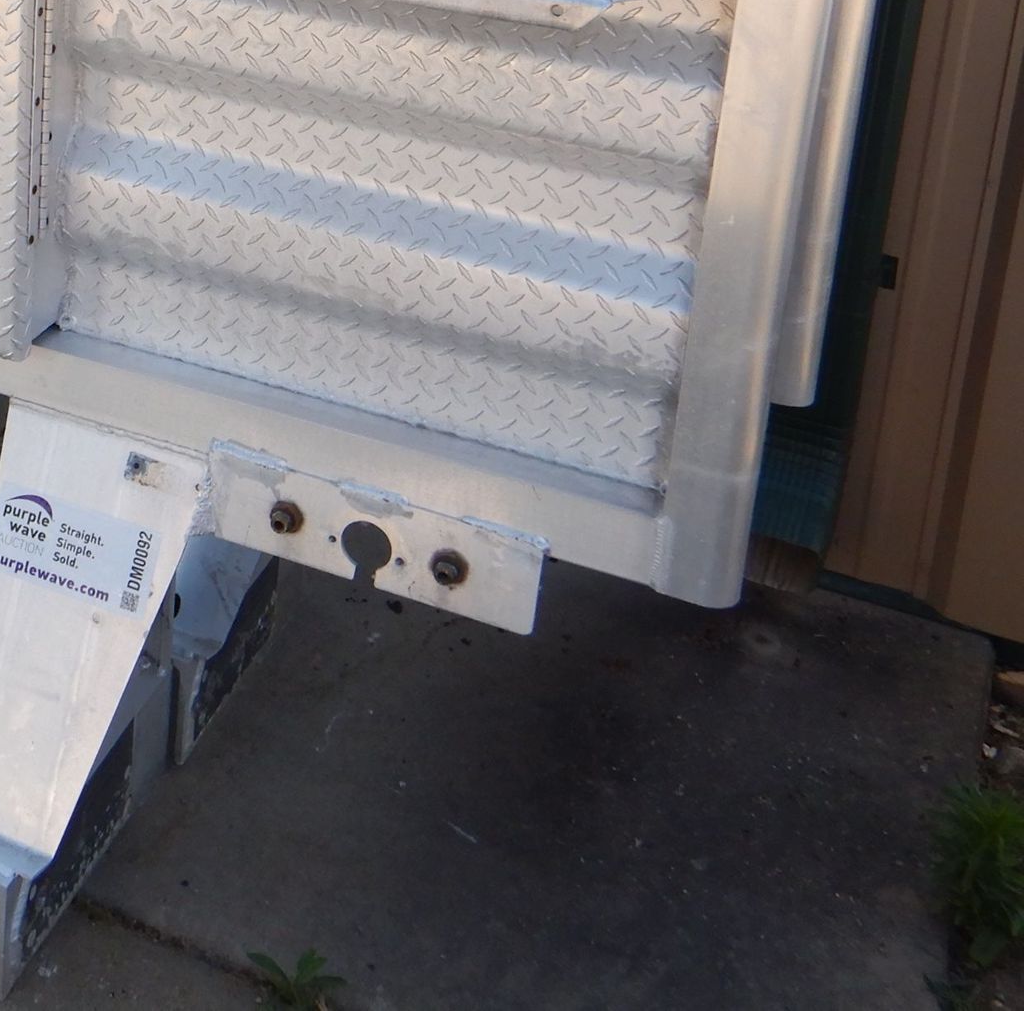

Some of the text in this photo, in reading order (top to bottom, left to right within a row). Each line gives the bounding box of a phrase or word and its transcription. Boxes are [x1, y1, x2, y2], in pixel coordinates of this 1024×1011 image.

[2, 503, 50, 527] purple
[9, 521, 47, 542] wave
[59, 523, 104, 547] Straight.
[52, 551, 79, 569] Sold.
[56, 537, 95, 560] Simple.
[127, 530, 153, 592] DM0092
